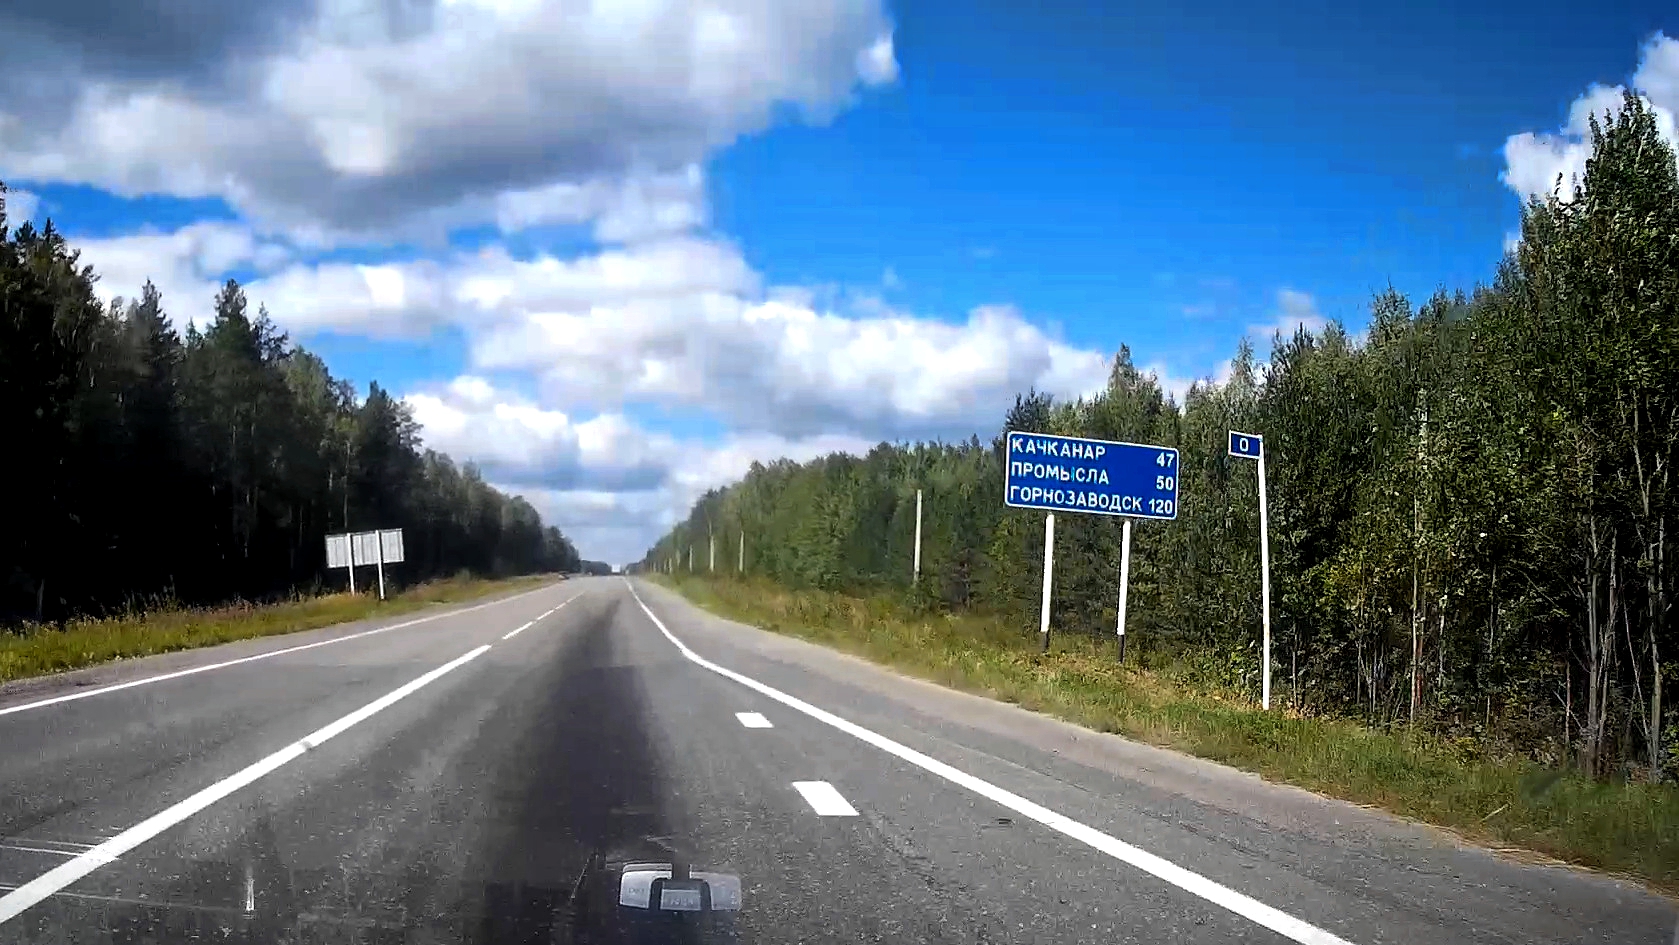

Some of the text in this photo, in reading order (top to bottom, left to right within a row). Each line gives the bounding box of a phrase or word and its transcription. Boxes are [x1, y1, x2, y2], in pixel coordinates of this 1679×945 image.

[1012, 438, 1175, 468] КАЧКАНАР 47
[1011, 461, 1174, 491] ПРОМЫСЛА 50
[1010, 485, 1174, 514] ГОРНОЗАВОДСК 120
